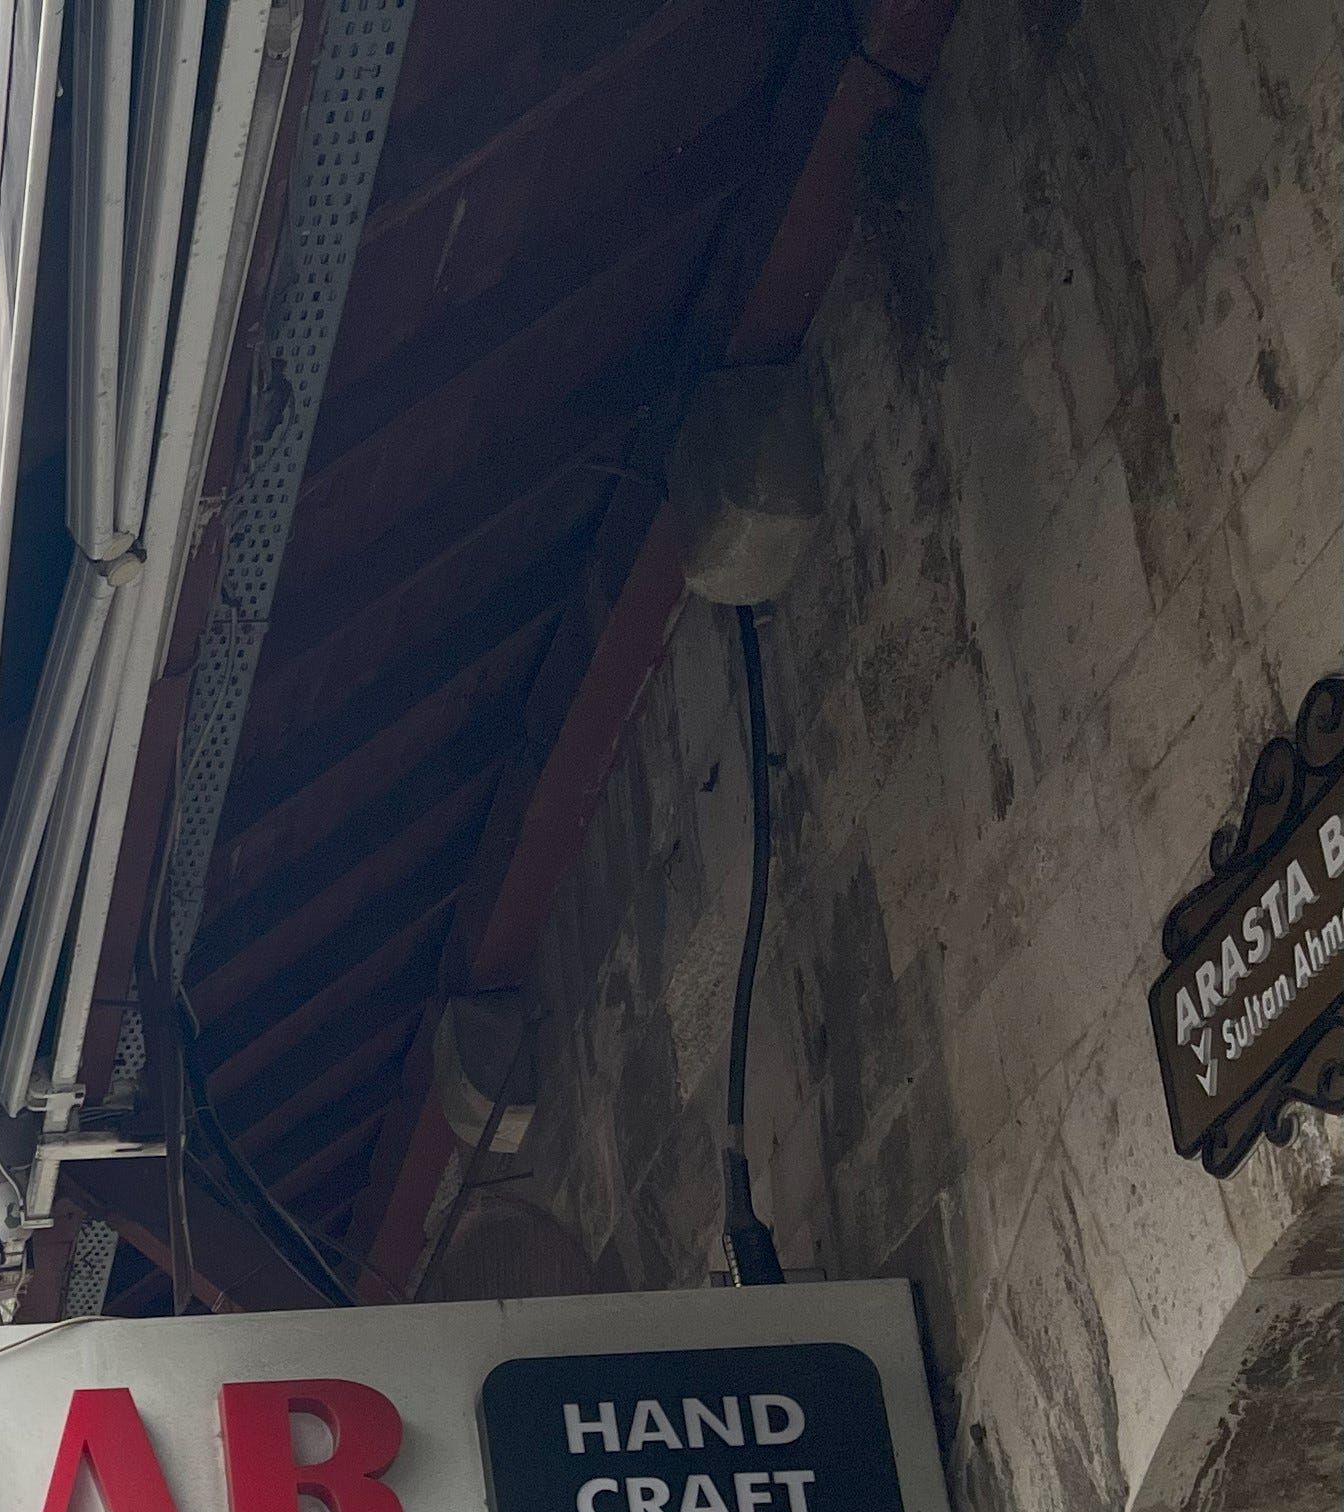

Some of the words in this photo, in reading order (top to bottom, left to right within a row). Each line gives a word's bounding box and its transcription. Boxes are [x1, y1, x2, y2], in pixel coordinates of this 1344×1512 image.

[1176, 859, 1320, 1046] ARASTA
[1223, 974, 1294, 1060] Sultan
[1294, 907, 1344, 989] Ahm
[563, 1394, 806, 1454] HAND
